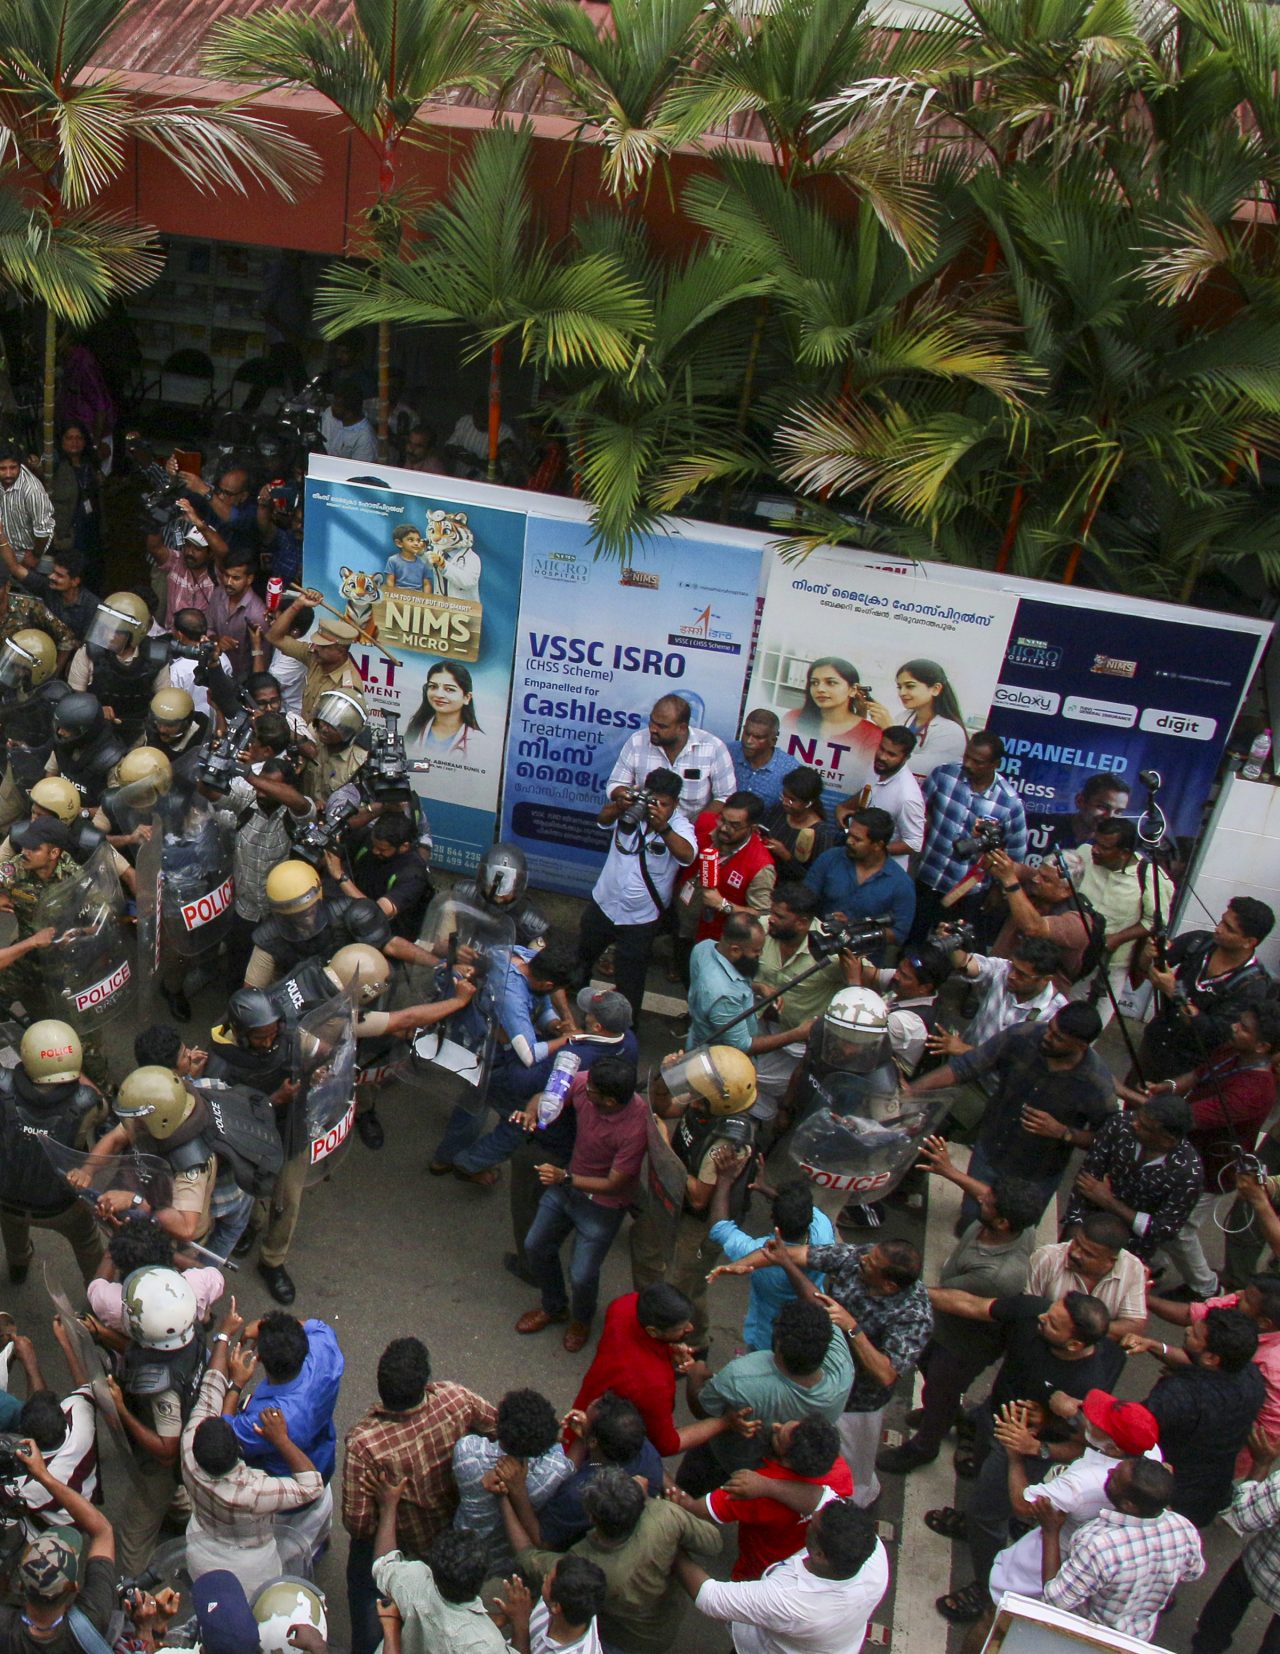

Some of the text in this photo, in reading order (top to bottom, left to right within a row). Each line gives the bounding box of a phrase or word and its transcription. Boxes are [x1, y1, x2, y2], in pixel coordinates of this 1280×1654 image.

[534, 569, 587, 582] HOSPITALS
[536, 559, 588, 576] MICRO
[632, 572, 658, 584] NIMS
[390, 592, 399, 600] AM
[400, 594, 412, 602] TOO
[412, 596, 425, 604] TINY
[425, 599, 437, 607] BUT
[438, 601, 449, 609] TOO
[791, 578, 995, 628] നിംസ് മൈക്രോ ഹോസ്പിറ്റൽസ്
[385, 601, 471, 643] NIMS
[402, 633, 449, 652] MICRO
[529, 632, 686, 678] VSSC ISRO
[1007, 654, 1057, 667] OSPITALS
[526, 658, 614, 683] (CHSS Scheme)
[1106, 660, 1134, 673] NIMS
[364, 684, 401, 699] MENT
[524, 677, 600, 697] Empanelled for
[995, 688, 1051, 711] Galaxy
[523, 693, 642, 730] Cashless
[521, 719, 605, 745] Treatment
[1156, 715, 1200, 734] digit
[518, 736, 597, 767] നിംസ്
[998, 736, 1128, 774] MPANELLED
[433, 759, 462, 769] ABHIRAMI
[996, 756, 1022, 776] OR
[816, 769, 845, 782] ENT
[1008, 776, 1056, 799] hless
[78, 965, 131, 1010] POLICE
[286, 978, 305, 1010] POLICE
[40, 1045, 74, 1060] POLICE
[210, 1100, 226, 1135] POLICE
[23, 1125, 49, 1137] POLICE
[313, 1104, 354, 1162] POLIC
[799, 1162, 891, 1193] POLICE
